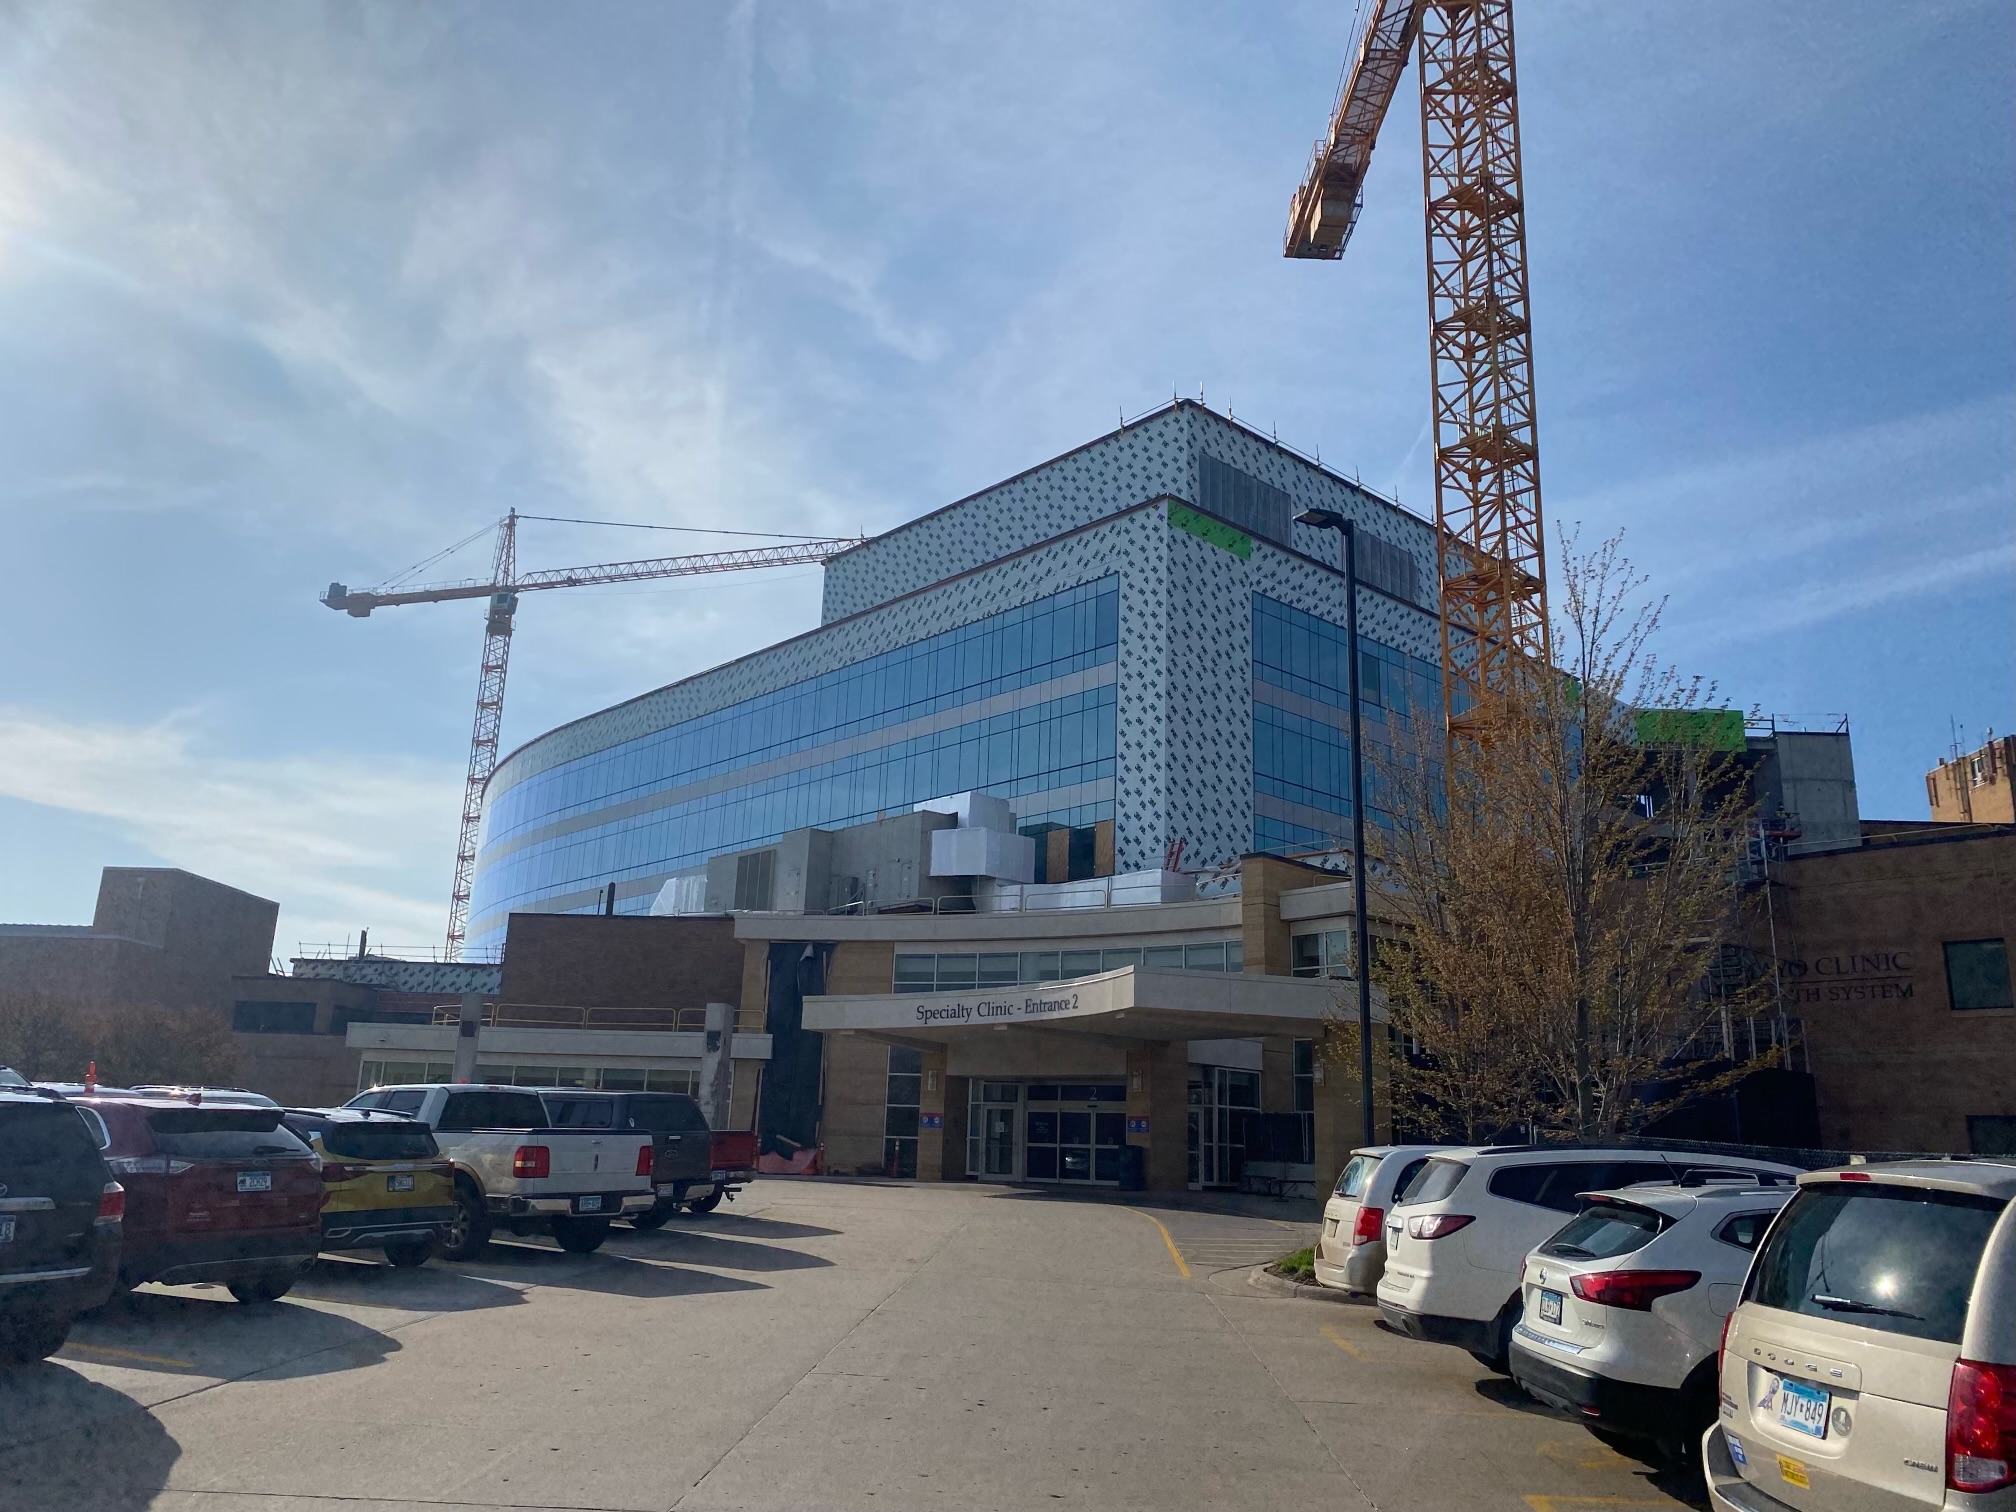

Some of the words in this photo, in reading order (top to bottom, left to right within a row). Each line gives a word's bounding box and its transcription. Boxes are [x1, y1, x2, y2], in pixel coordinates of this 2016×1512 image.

[1815, 951, 1911, 976] CLINIC
[1829, 983, 1914, 1001] SYSTEM
[916, 1003, 973, 1024] Specialty
[977, 1001, 1013, 1017] Clinic
[1024, 998, 1070, 1014] Entrance
[1072, 993, 1079, 1009] 2
[1090, 1087, 1098, 1101] 2
